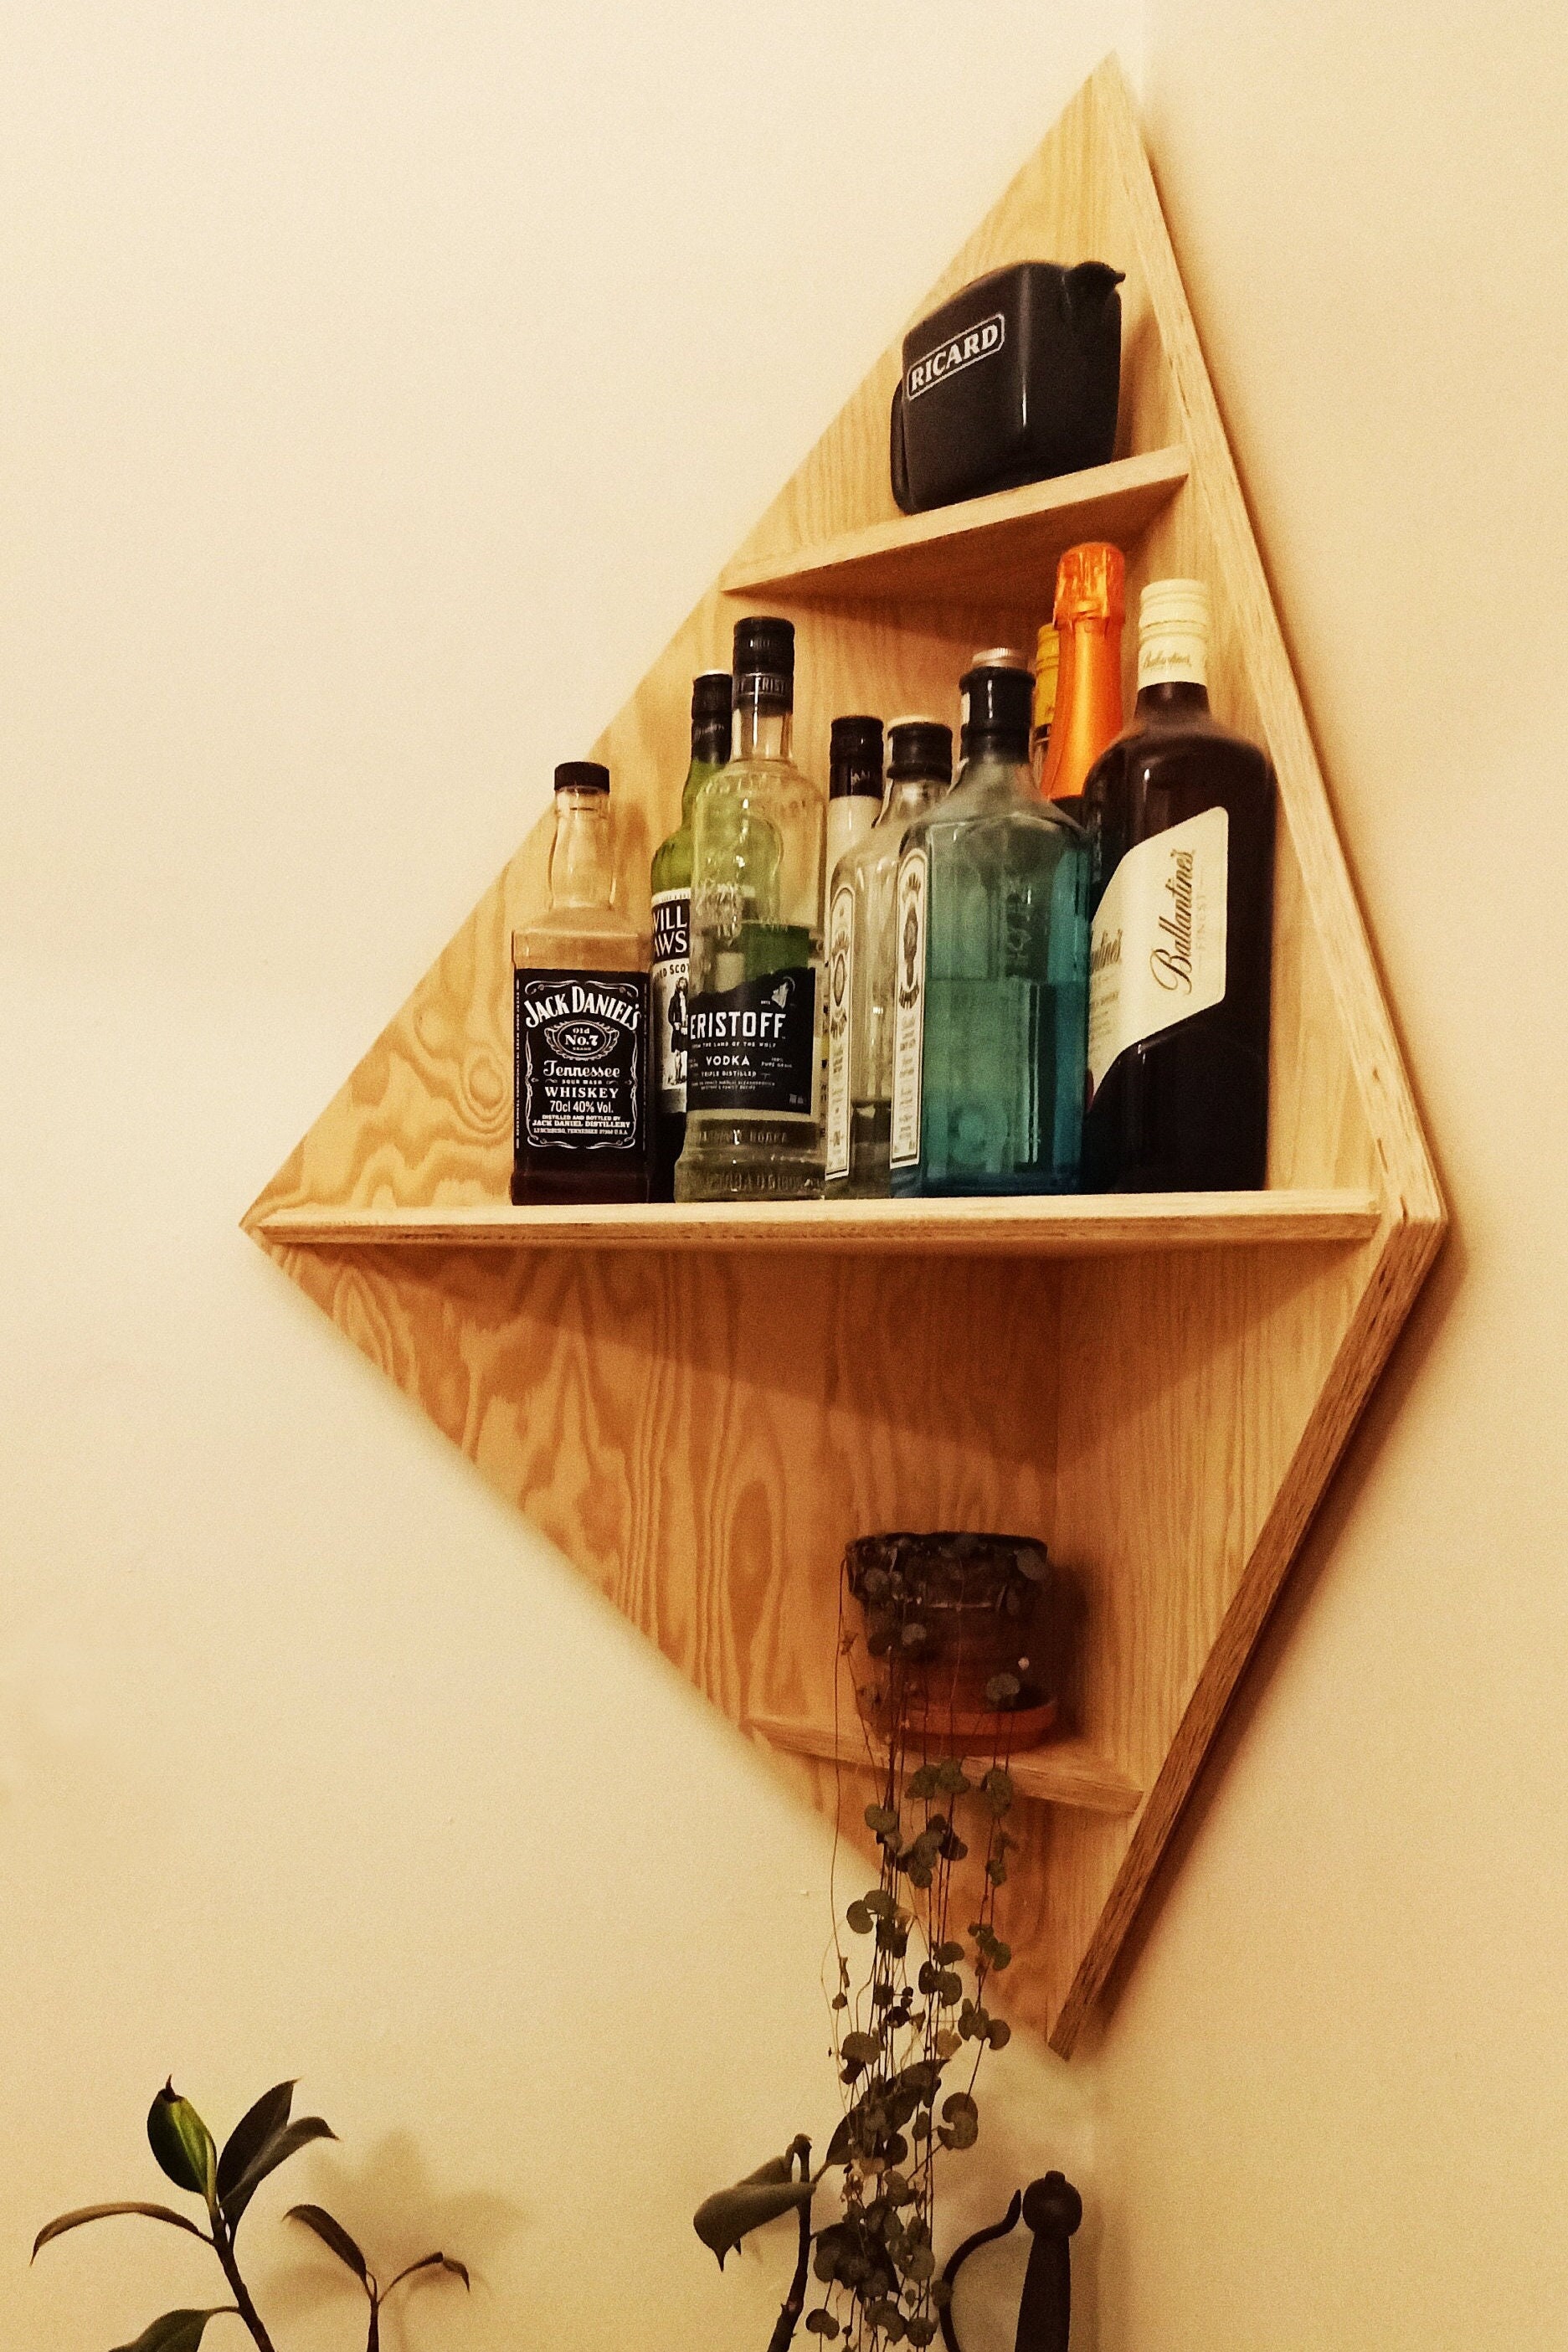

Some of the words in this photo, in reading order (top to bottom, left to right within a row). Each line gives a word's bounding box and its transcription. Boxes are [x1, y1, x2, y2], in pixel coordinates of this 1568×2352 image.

[911, 324, 998, 392] RICARD
[1150, 849, 1195, 995] Ballantine's
[524, 993, 570, 1028] JACK
[572, 986, 642, 1032] DANIEL'S
[690, 1011, 787, 1040] ERISTOFF
[565, 1034, 599, 1047] No.7
[543, 1059, 620, 1078] Tennessee
[706, 1055, 750, 1066] VODKA
[544, 1086, 619, 1099] WHISKEY
[550, 1100, 571, 1113] 70cl
[573, 1100, 595, 1114] 40%
[597, 1101, 614, 1114] Vol.
[585, 1120, 630, 1129] DISTILLERY
